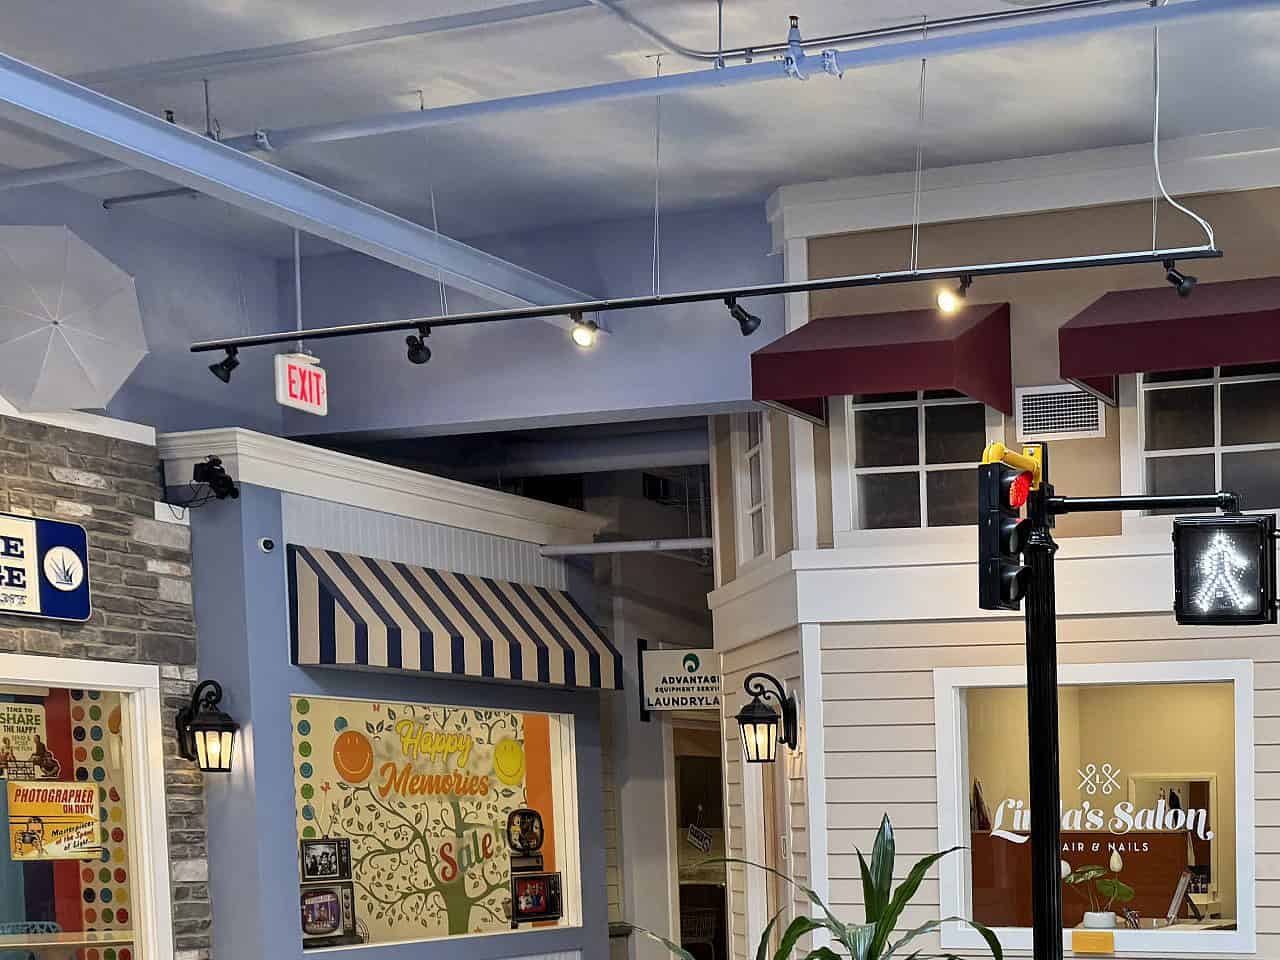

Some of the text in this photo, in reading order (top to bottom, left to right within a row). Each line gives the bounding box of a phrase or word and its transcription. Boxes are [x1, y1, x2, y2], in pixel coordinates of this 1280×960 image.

[288, 364, 321, 406] EXIT
[3, 725, 37, 734] THE HAPPY
[395, 719, 473, 769] Happy
[14, 788, 95, 803] PHOTOGRAPHER
[378, 762, 489, 797] Memories
[63, 804, 95, 815] ON DUTY
[1108, 799, 1215, 841] Salon
[439, 829, 494, 882] Sale
[1062, 842, 1149, 852] AIR & NAILS
